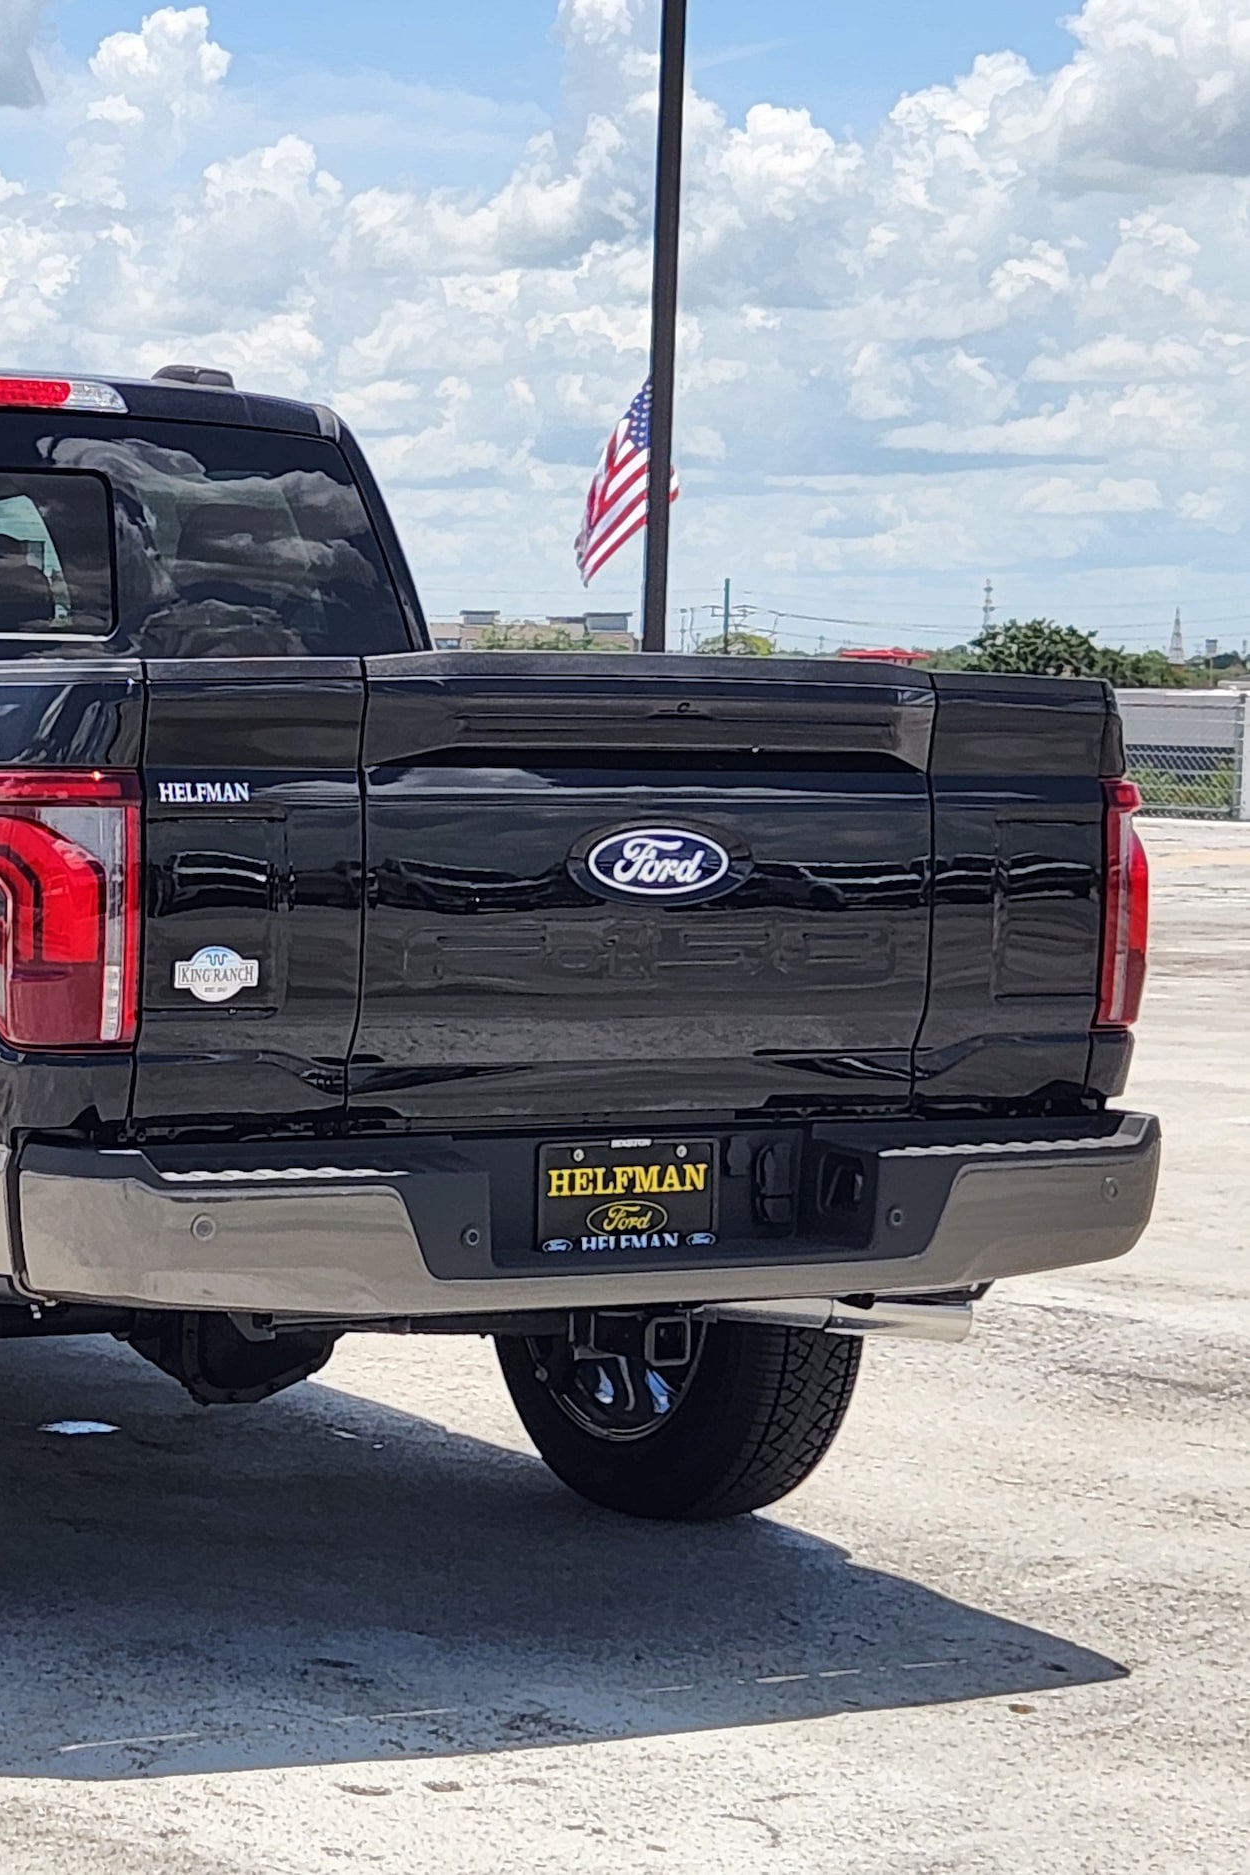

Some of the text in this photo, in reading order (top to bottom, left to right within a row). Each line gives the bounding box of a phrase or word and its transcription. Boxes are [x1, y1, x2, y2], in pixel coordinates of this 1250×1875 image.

[158, 782, 250, 803] HELFMAN
[612, 837, 705, 883] Ford
[181, 965, 254, 983] KING RANCH
[547, 1163, 709, 1197] HELFMAN
[602, 1205, 653, 1231] Ford
[581, 1232, 679, 1251] HELFMAN
